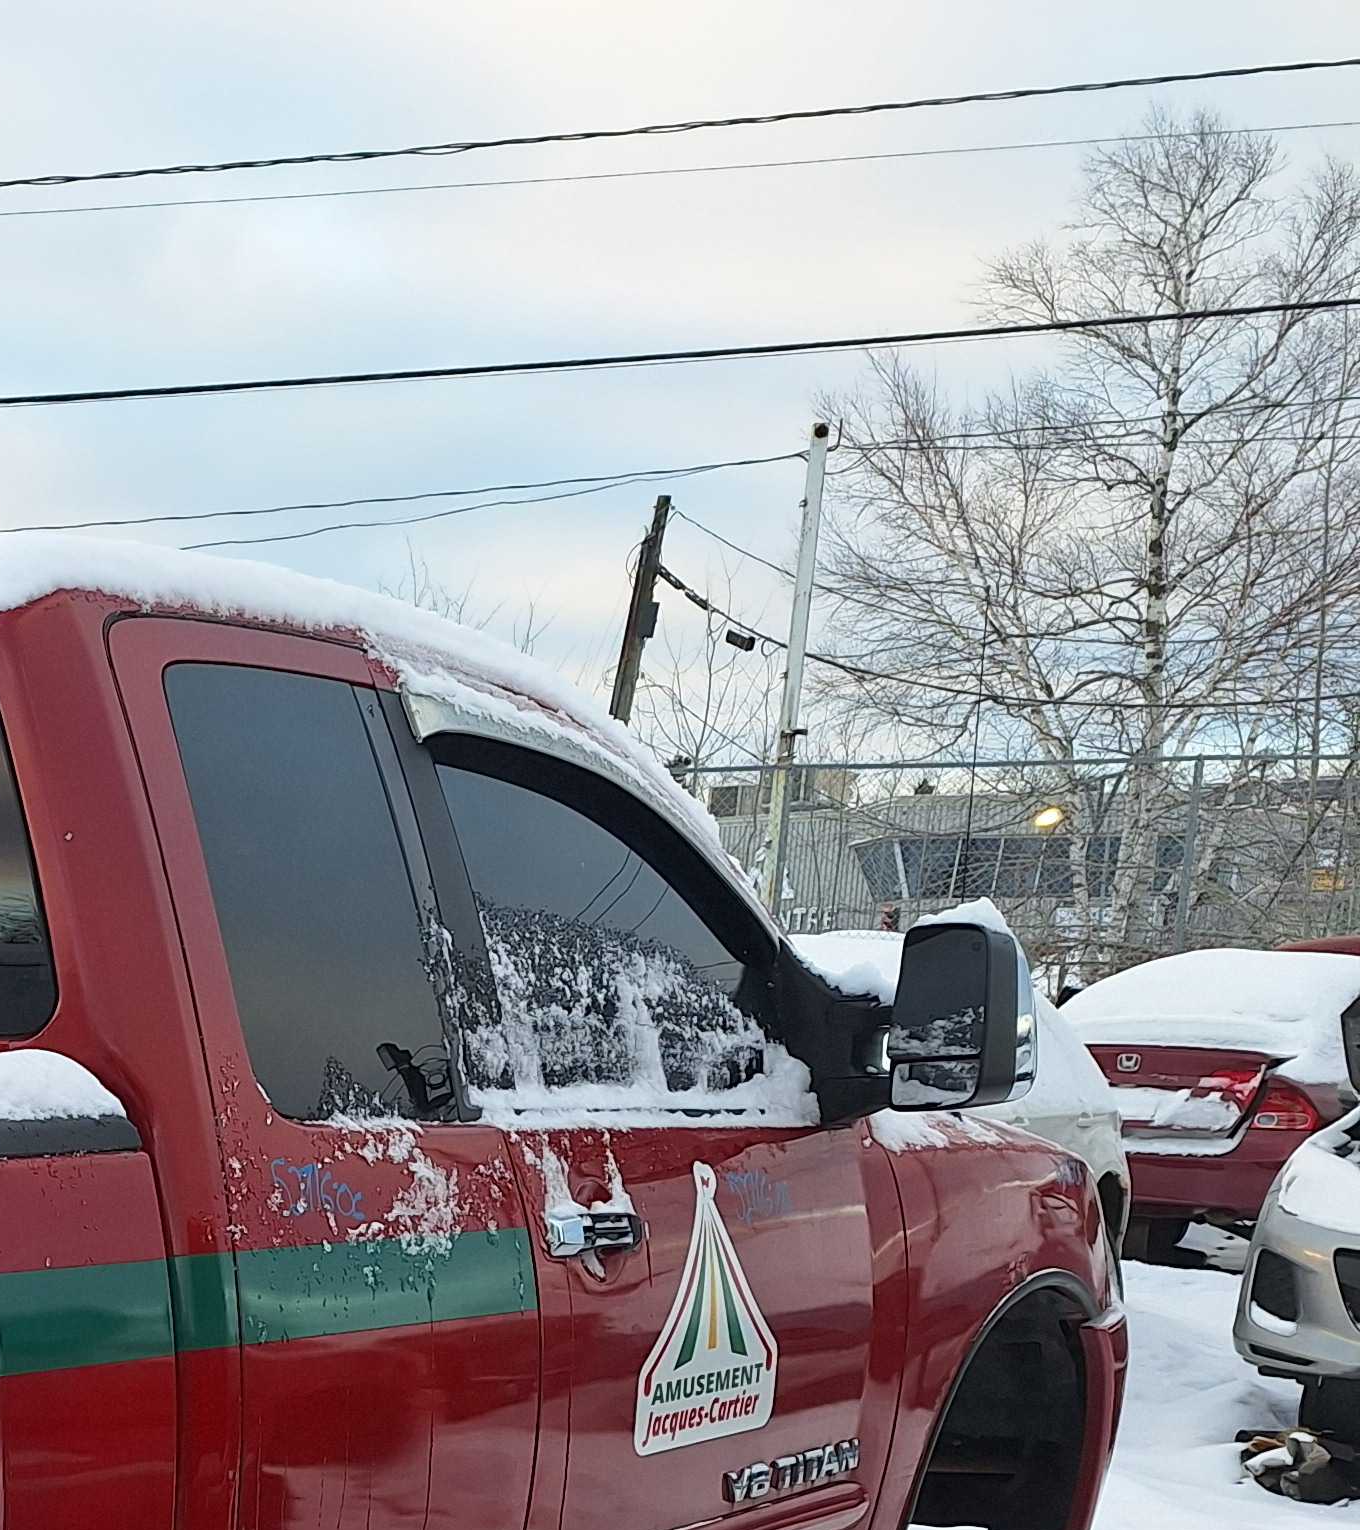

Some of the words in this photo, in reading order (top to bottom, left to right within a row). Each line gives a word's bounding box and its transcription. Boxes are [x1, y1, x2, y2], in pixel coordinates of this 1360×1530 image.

[651, 1362, 763, 1406] AMUSEMENT
[641, 1389, 760, 1448] Jacques-Cartier
[724, 1462, 771, 1502] V8
[773, 1438, 860, 1489] TITAN
